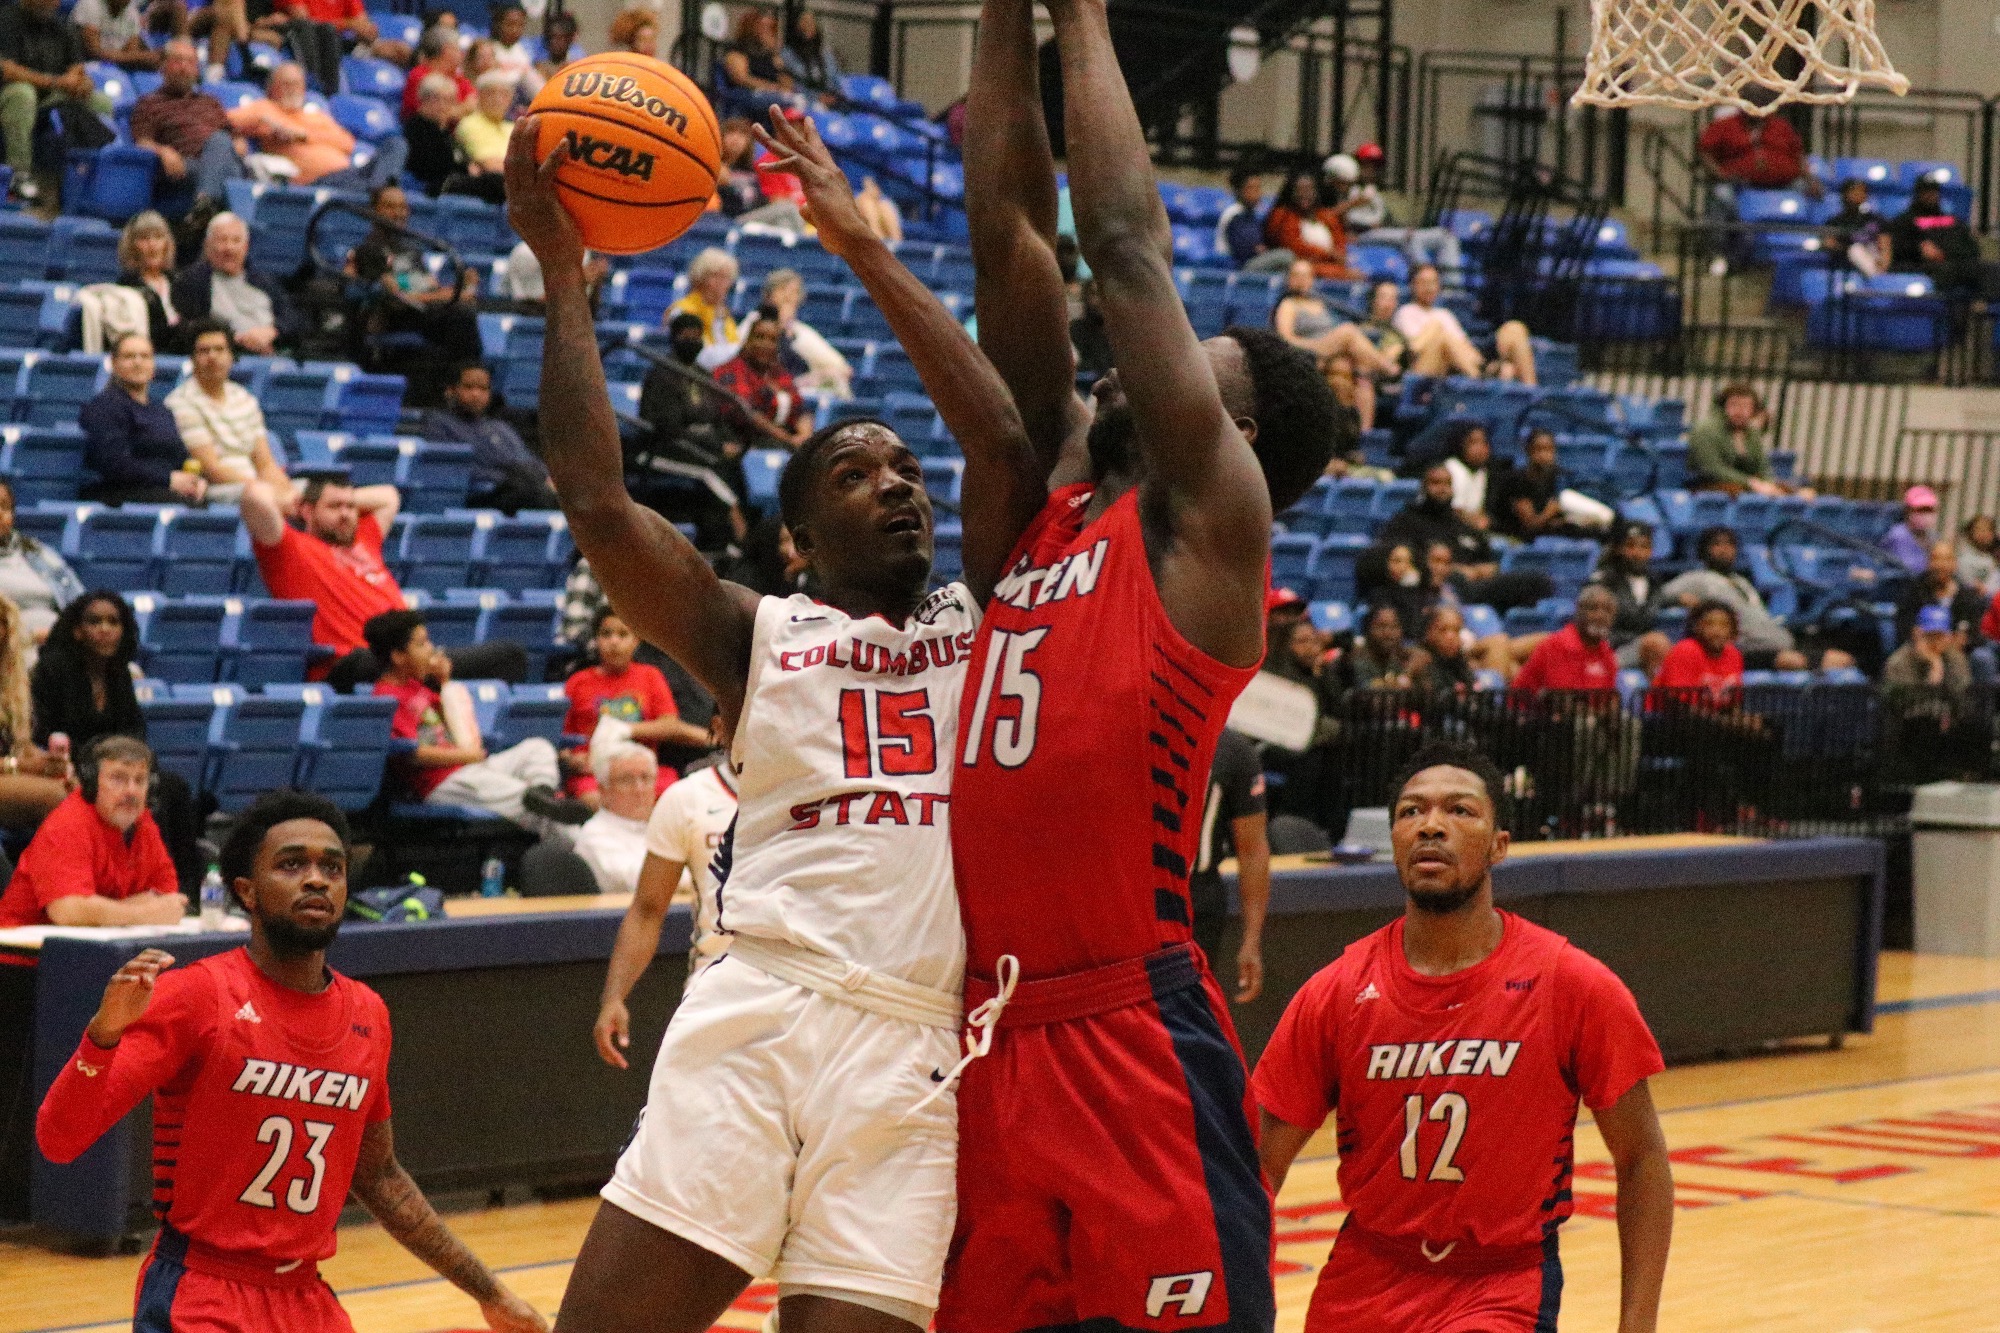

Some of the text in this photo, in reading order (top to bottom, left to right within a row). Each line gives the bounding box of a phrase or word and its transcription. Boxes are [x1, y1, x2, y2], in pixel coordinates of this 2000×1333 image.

[563, 72, 689, 136] Wilson
[565, 130, 656, 182] NCAA
[992, 537, 1108, 612] IKEN
[780, 629, 974, 677] COLUMBUS
[961, 624, 1053, 770] 15
[838, 687, 937, 779] 15
[788, 790, 952, 830] STAT
[231, 1056, 370, 1112] AIKEN
[1366, 1038, 1522, 1081] AIKEN
[237, 1114, 336, 1215] 23
[1399, 1090, 1469, 1184] 12
[1144, 1268, 1214, 1319] A
